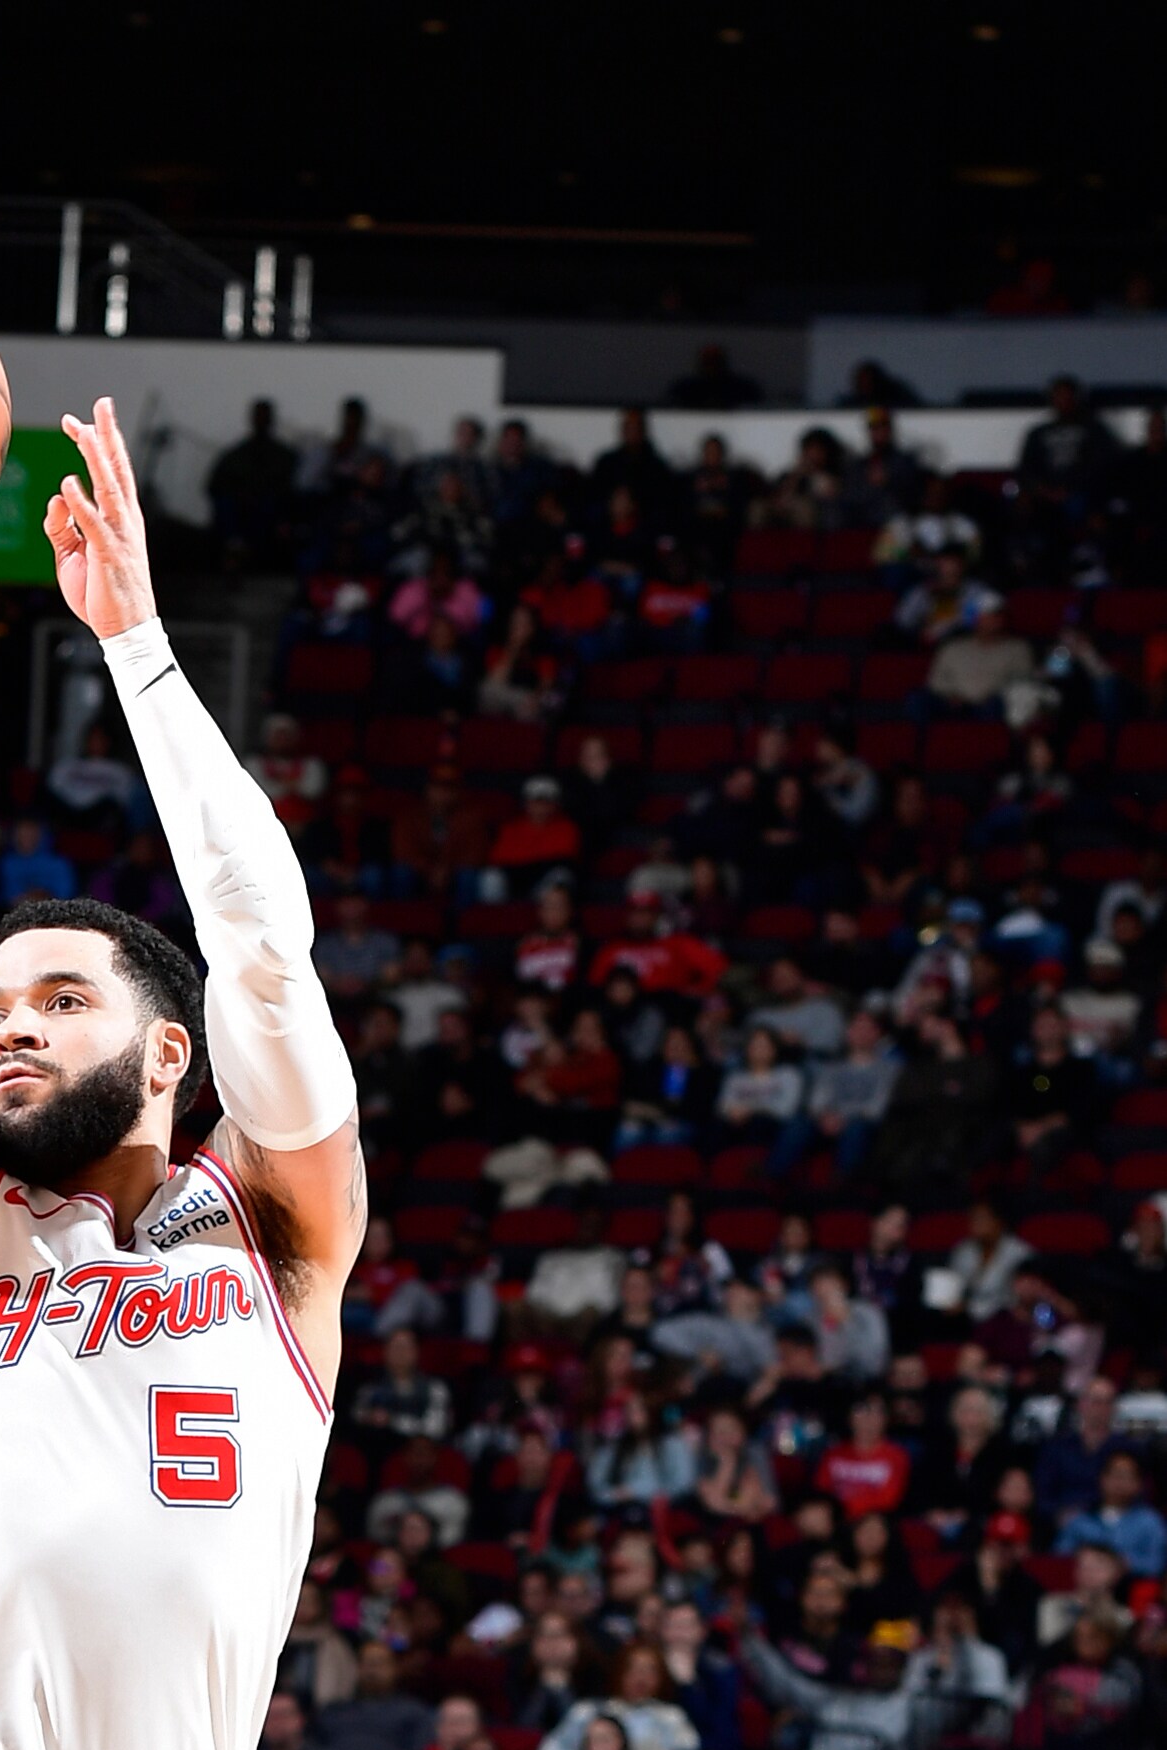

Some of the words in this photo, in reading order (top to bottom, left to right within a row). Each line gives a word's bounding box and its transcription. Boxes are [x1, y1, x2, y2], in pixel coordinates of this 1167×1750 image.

[147, 1188, 219, 1237] credit
[150, 1209, 231, 1254] karma
[148, 1384, 243, 1509] 5
